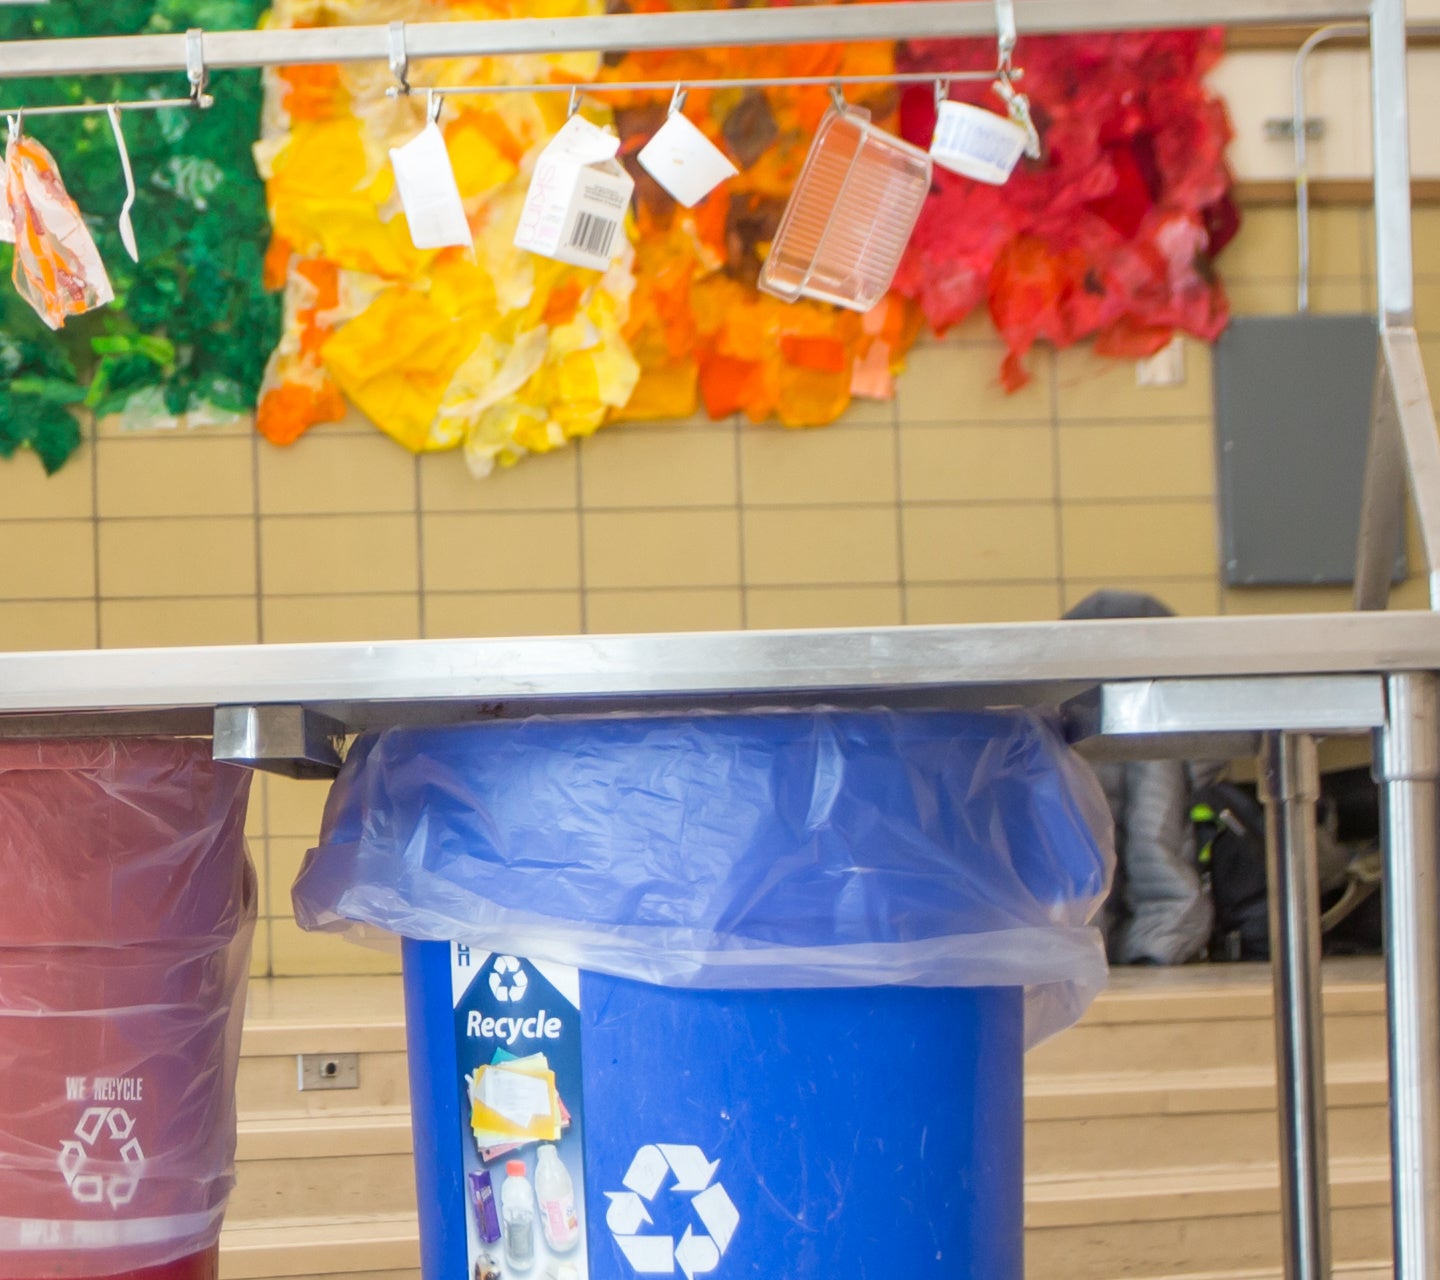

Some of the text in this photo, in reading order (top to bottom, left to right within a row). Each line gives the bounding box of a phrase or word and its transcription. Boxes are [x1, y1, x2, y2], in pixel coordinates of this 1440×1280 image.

[467, 1010, 562, 1045] Recycle
[65, 1076, 143, 1101] WE RECYCLE
